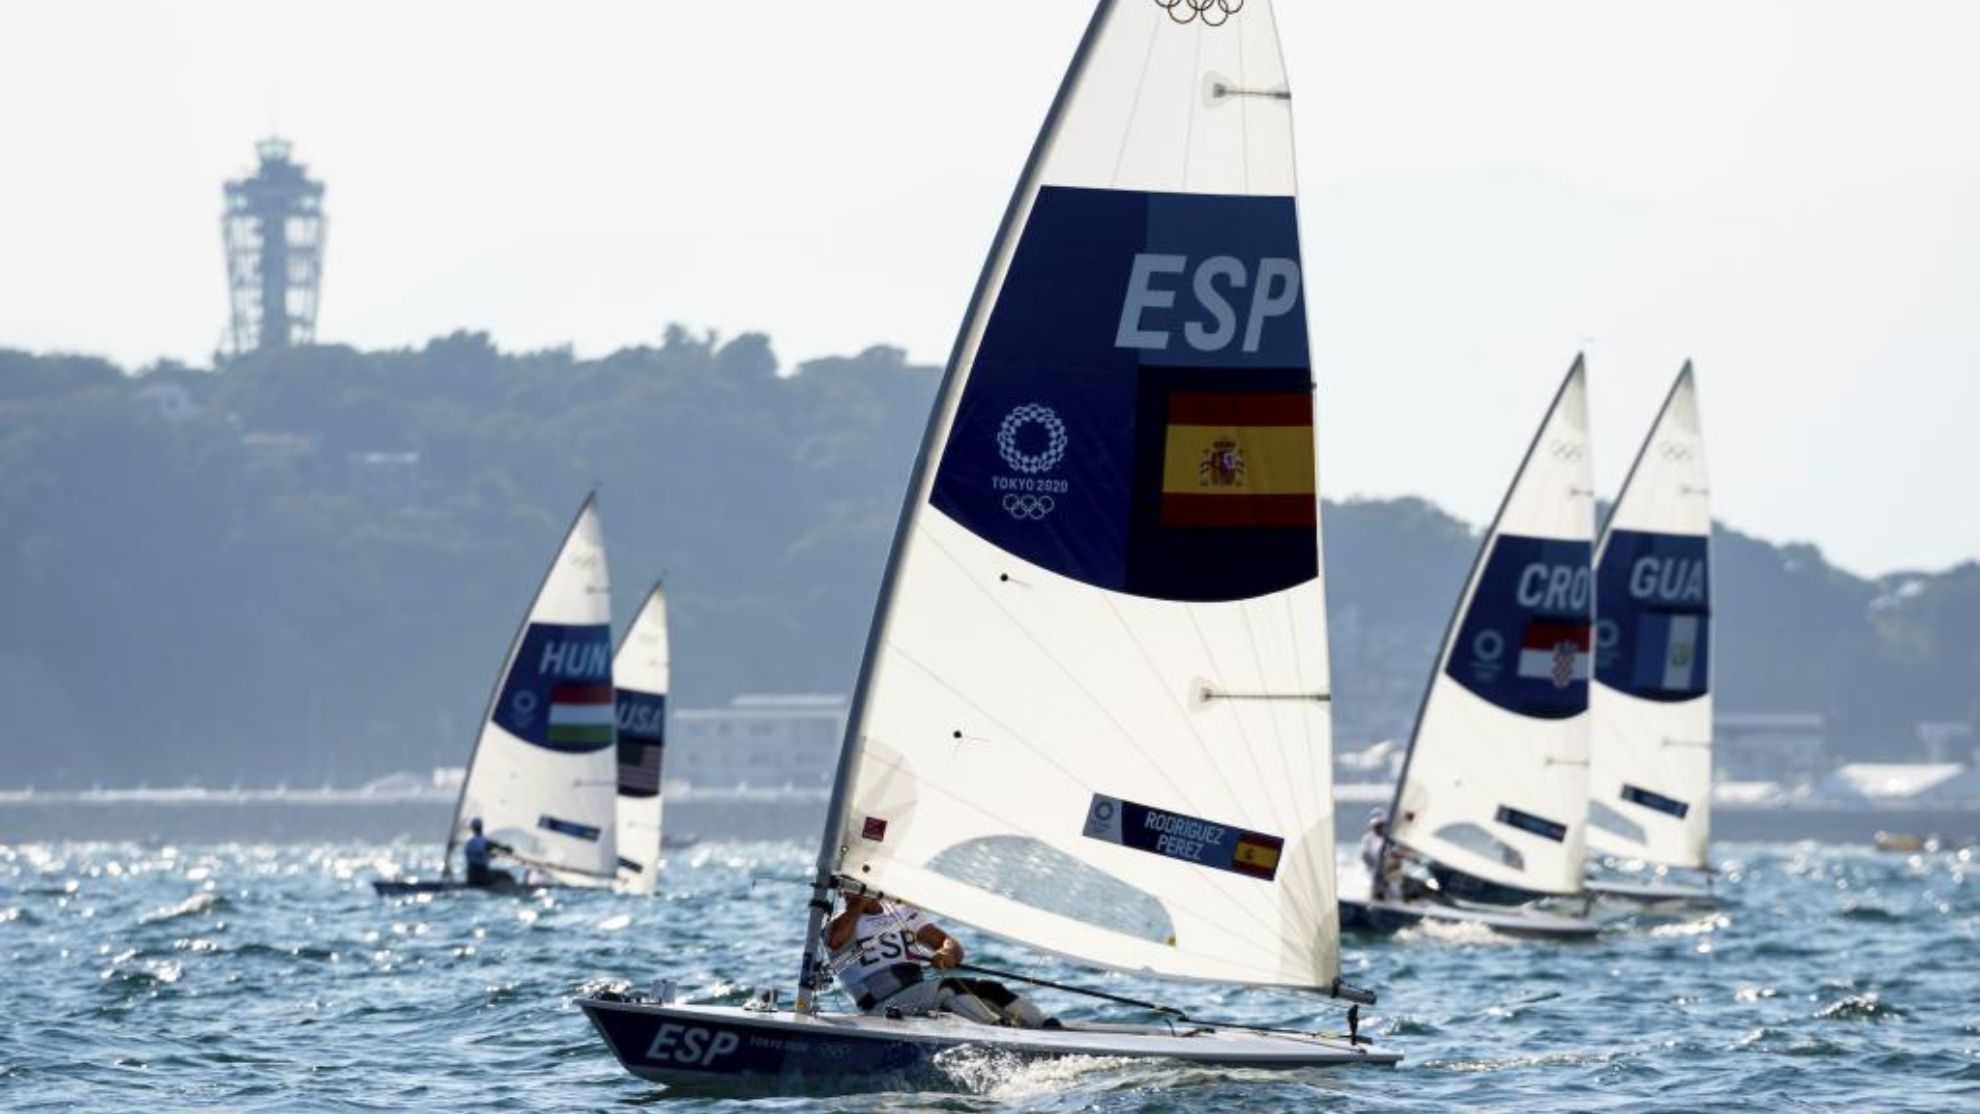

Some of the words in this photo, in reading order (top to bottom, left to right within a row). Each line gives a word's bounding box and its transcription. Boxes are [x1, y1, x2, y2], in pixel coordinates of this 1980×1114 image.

[1114, 253, 1300, 352] ESP
[992, 477, 1034, 491] TOKYO
[1036, 480, 1068, 493] 2020
[1517, 563, 1591, 609] CRO
[1630, 557, 1704, 600] GUA
[541, 642, 609, 676] HUN
[1144, 811, 1225, 845] RODRIGUEZ
[1156, 834, 1204, 860] PEREZ
[856, 929, 917, 966] ESP
[646, 1023, 740, 1065] ESP
